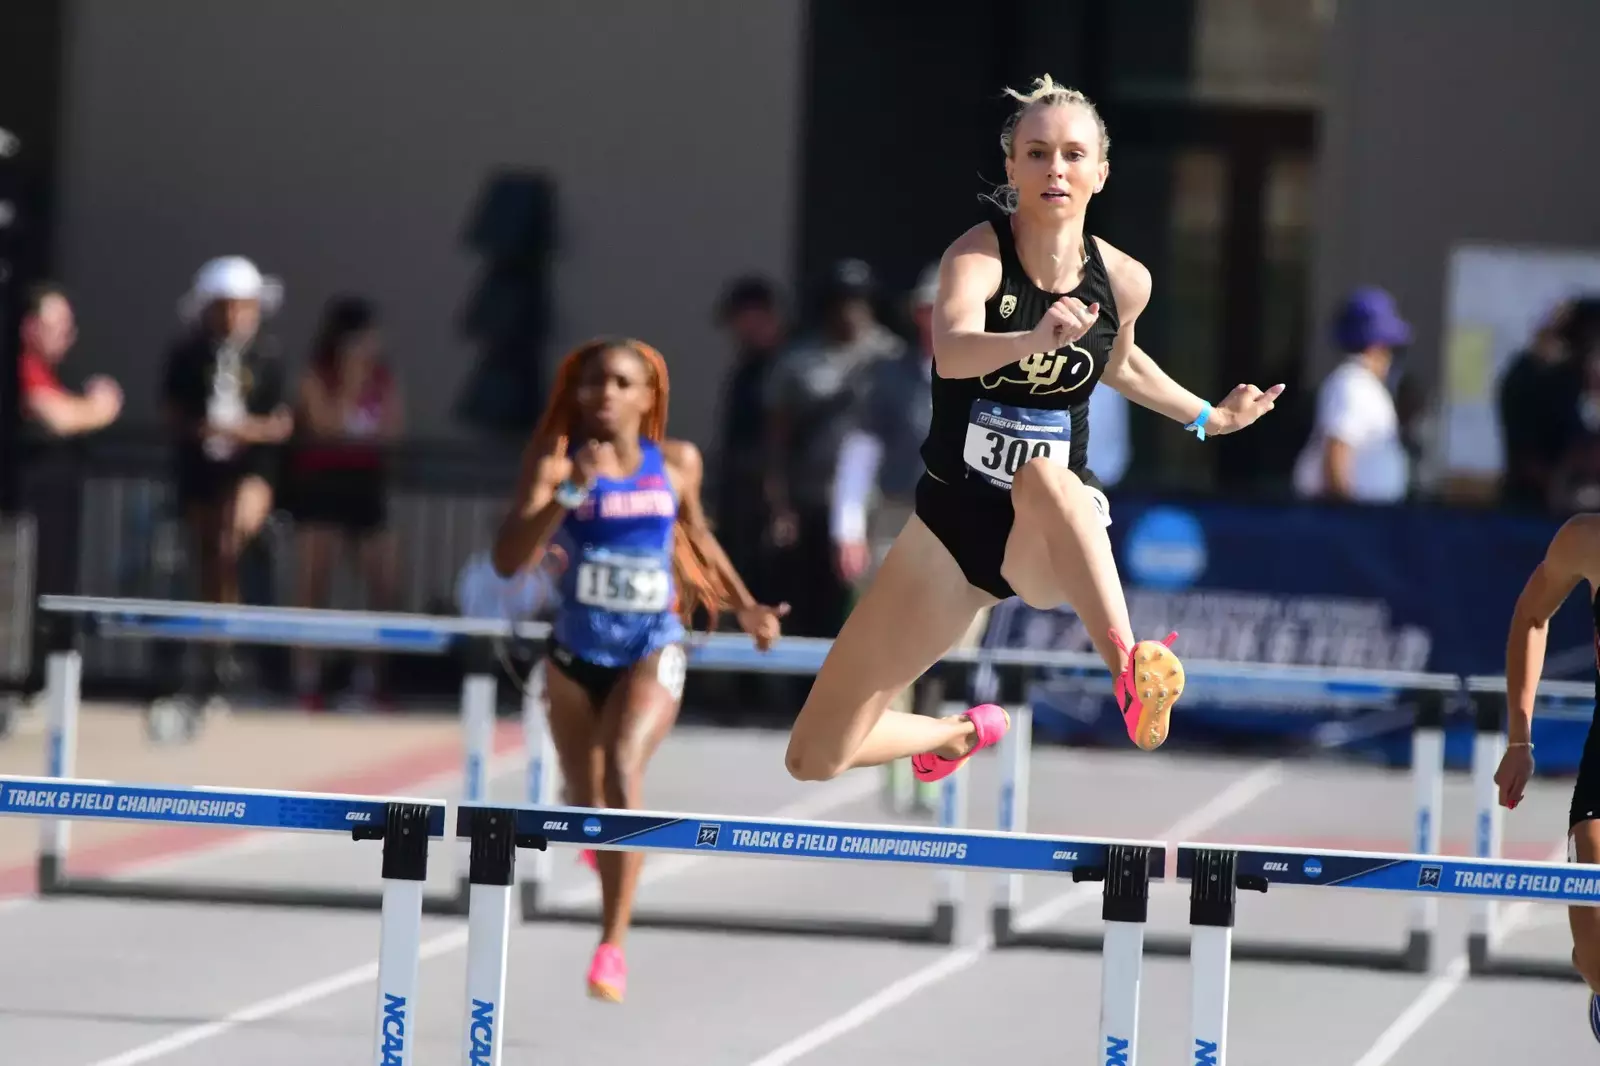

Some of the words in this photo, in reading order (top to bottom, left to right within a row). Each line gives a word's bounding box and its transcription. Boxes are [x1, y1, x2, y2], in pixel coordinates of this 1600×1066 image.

[8, 789, 57, 808] TRACK
[58, 791, 70, 809] &
[72, 793, 114, 811] FIELD
[117, 795, 247, 818] CHAMPIONSHIPS
[345, 811, 371, 821] GILL
[543, 821, 568, 831] GILL
[732, 829, 779, 848] TRACK
[782, 833, 794, 849] &
[796, 834, 836, 852] FIELD
[840, 837, 967, 859] CHAMPIONSHIPS
[1052, 850, 1078, 860] GILL
[1263, 861, 1289, 871] GILL
[1454, 870, 1503, 889] TRACK
[1505, 874, 1516, 890] &
[1518, 874, 1561, 893] FIELD
